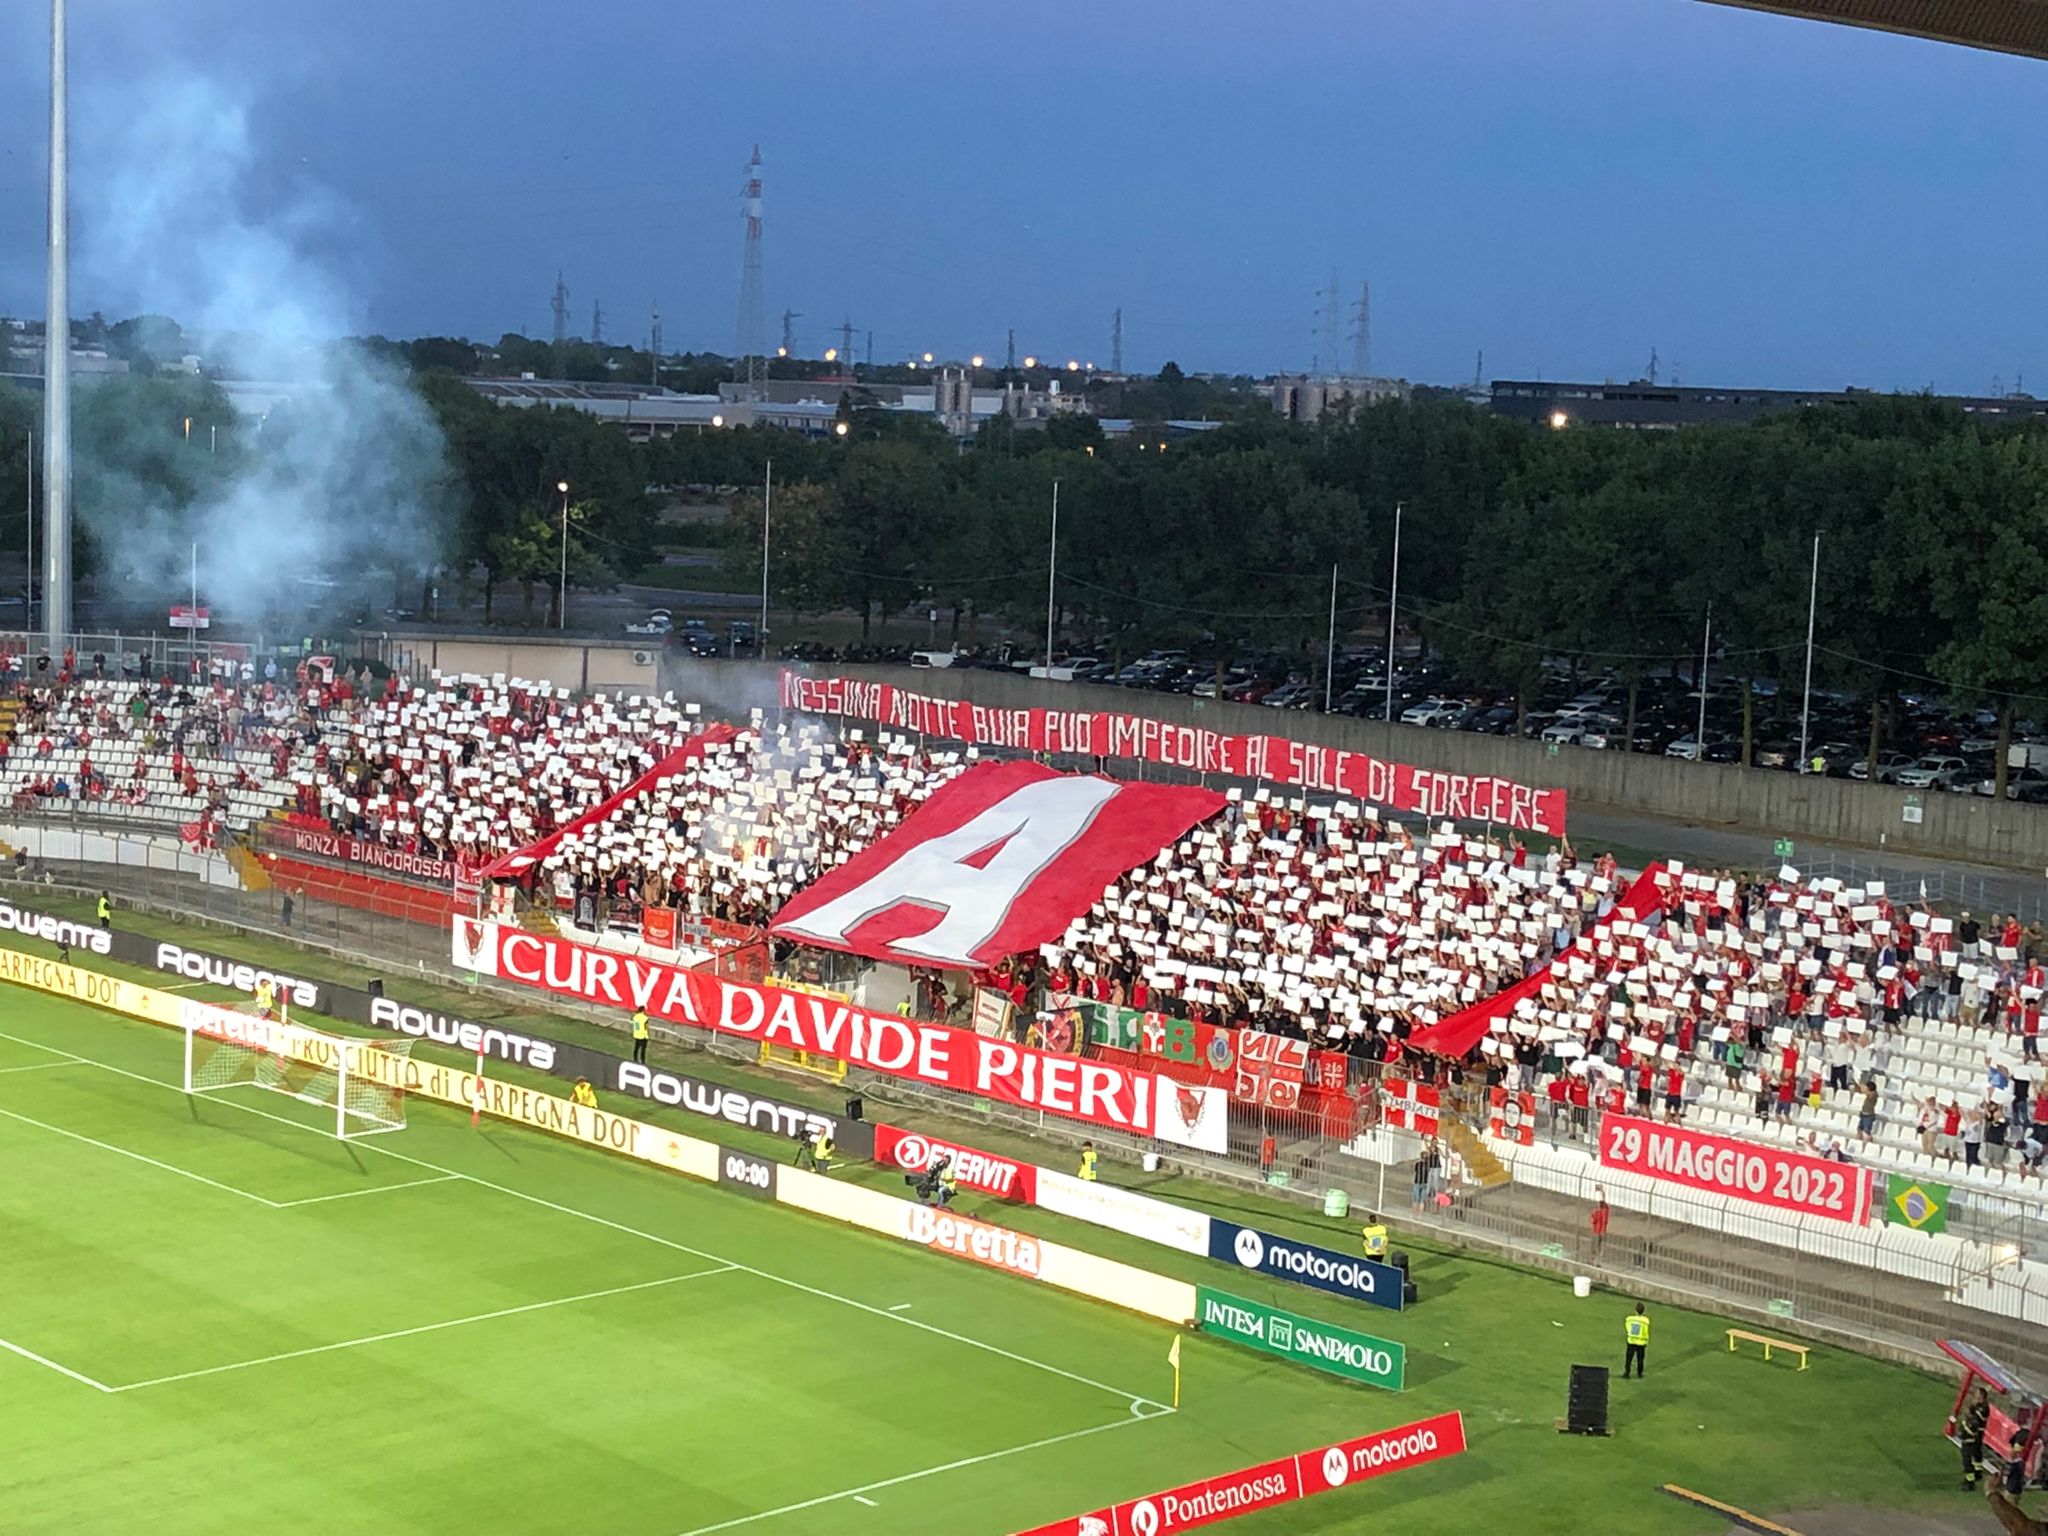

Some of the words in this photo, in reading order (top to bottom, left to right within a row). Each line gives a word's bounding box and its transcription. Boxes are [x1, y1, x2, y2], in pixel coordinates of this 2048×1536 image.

[785, 671, 881, 721] NESSUNA
[890, 688, 961, 739] NOTTE
[973, 705, 1029, 748] BUIA
[1109, 715, 1235, 774] IMPEDIRE
[1247, 735, 1274, 779] AL
[1288, 742, 1351, 794] SOLE
[1369, 758, 1396, 805] DI
[1411, 769, 1551, 833] SORGERE
[296, 832, 341, 857] MONZA
[350, 843, 453, 880] BIANCOROSSA
[0, 904, 112, 954] owenta
[0, 952, 78, 995] ARPEGNA
[502, 934, 699, 1023] CURVA
[719, 980, 950, 1081] DAVIDE
[976, 1039, 1149, 1129] PIERI
[430, 1069, 449, 1099] di
[460, 1075, 581, 1136] CARPEGNA
[726, 1156, 769, 1189] 00:00
[1608, 1126, 1642, 1163] 29
[1647, 1133, 1767, 1193] MAGGIO
[1773, 1162, 1845, 1211] 2022
[910, 1205, 1041, 1276] Beretta
[1269, 1246, 1375, 1293] motorola
[1205, 1298, 1265, 1340] INTESA
[1294, 1328, 1393, 1375] SANPAOLO
[1351, 1428, 1437, 1472] motorola
[1162, 1472, 1288, 1527] Pontenossa
